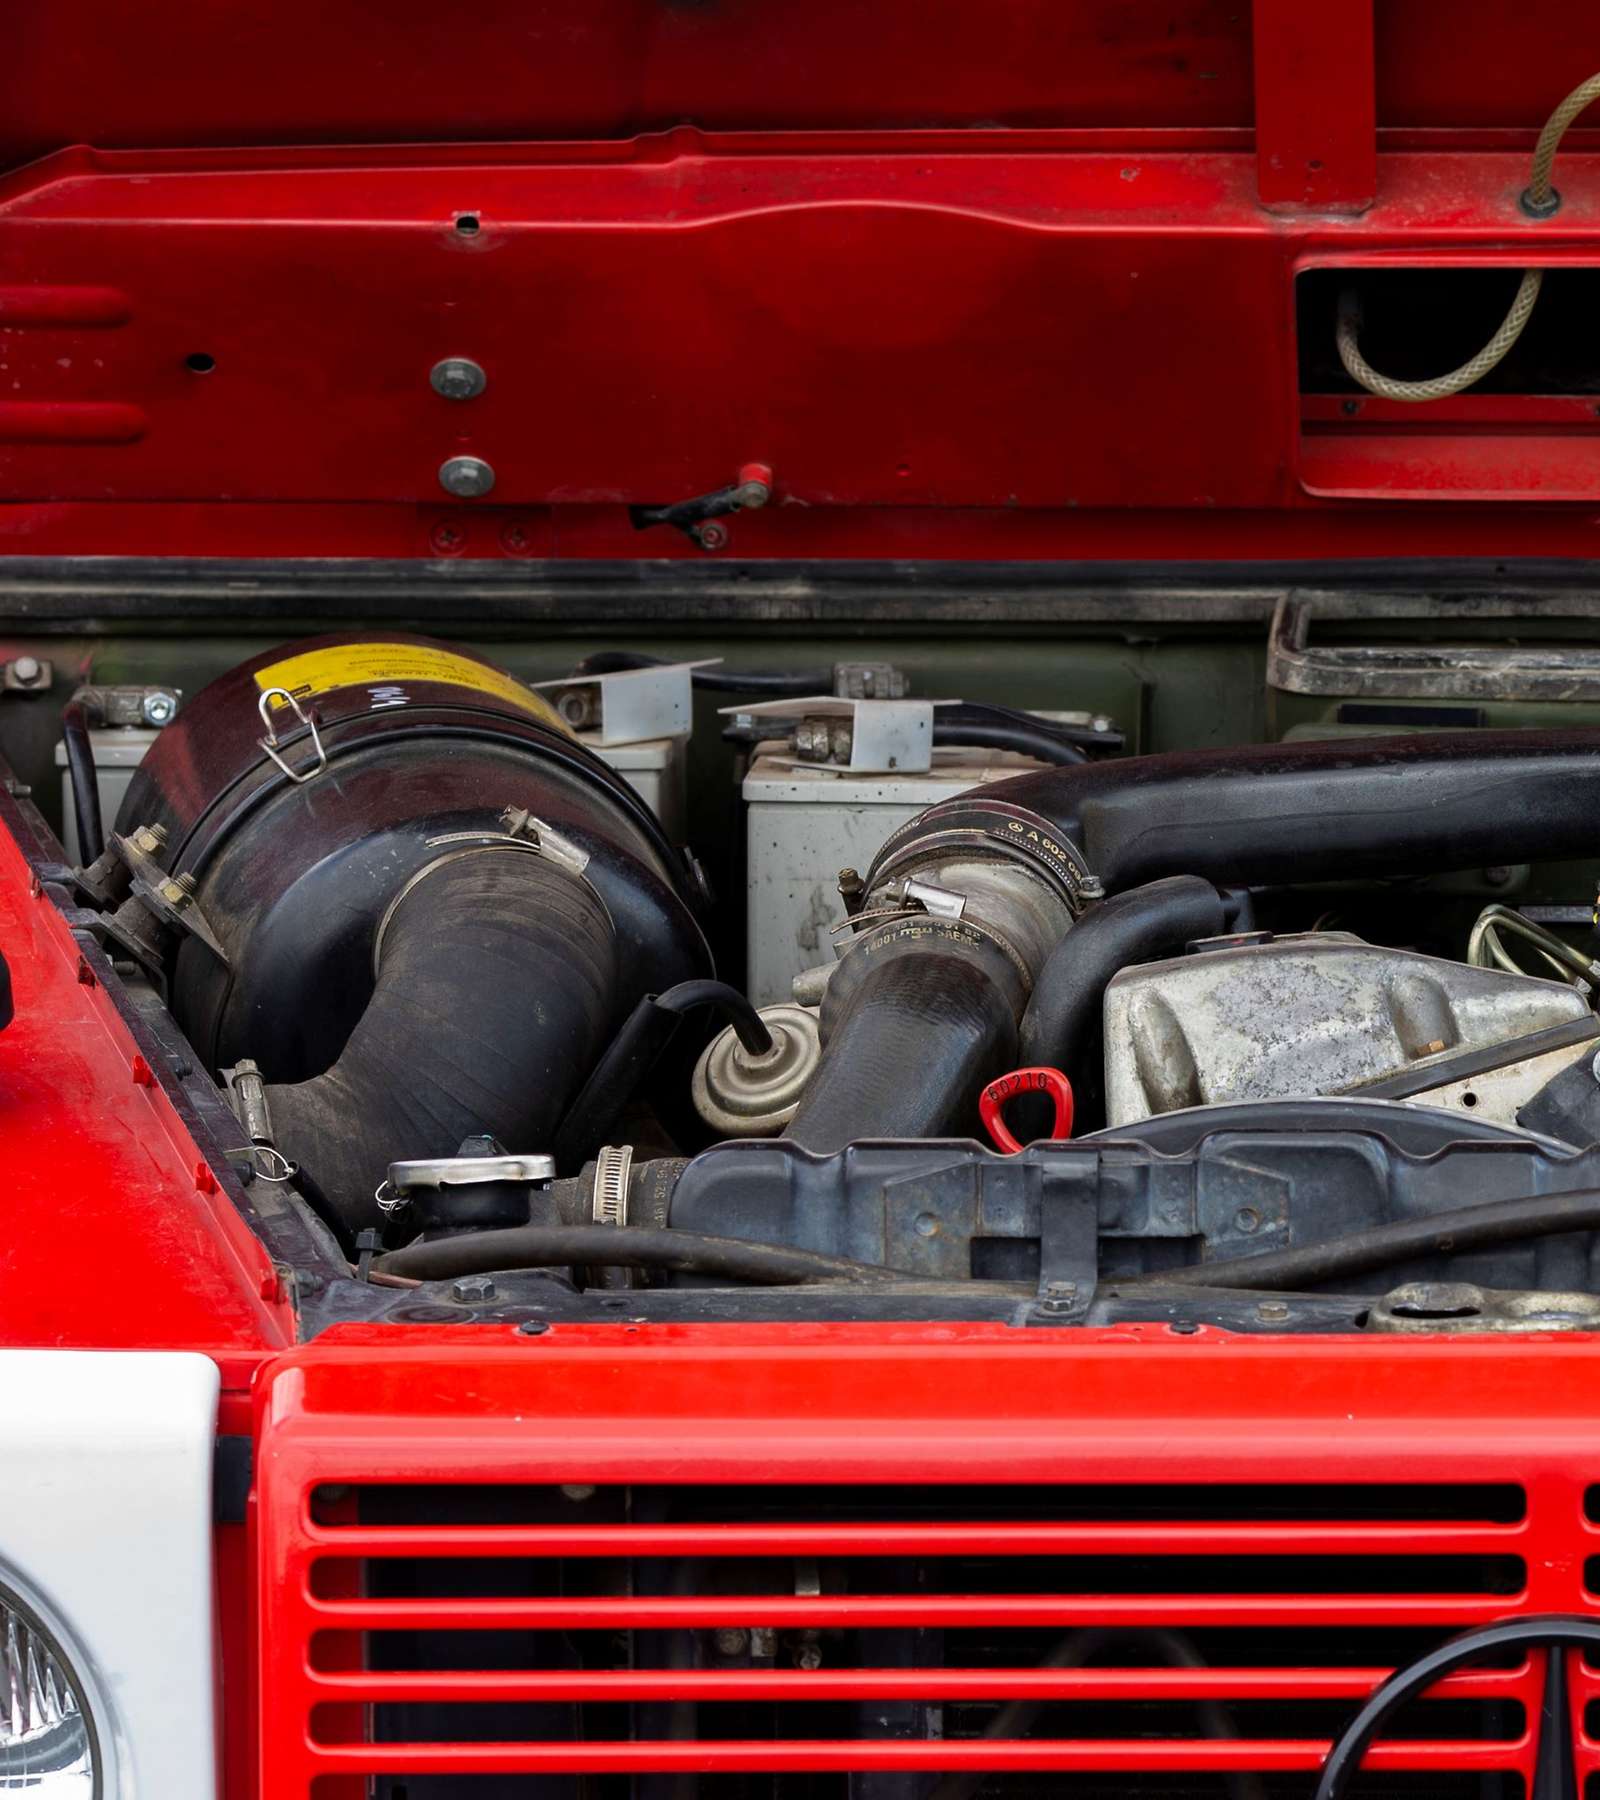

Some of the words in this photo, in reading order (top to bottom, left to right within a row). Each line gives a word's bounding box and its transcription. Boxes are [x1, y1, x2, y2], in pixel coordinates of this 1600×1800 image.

[1026, 831, 1039, 842] A
[1042, 838, 1068, 863] 602
[987, 1072, 1049, 1103] 60210
